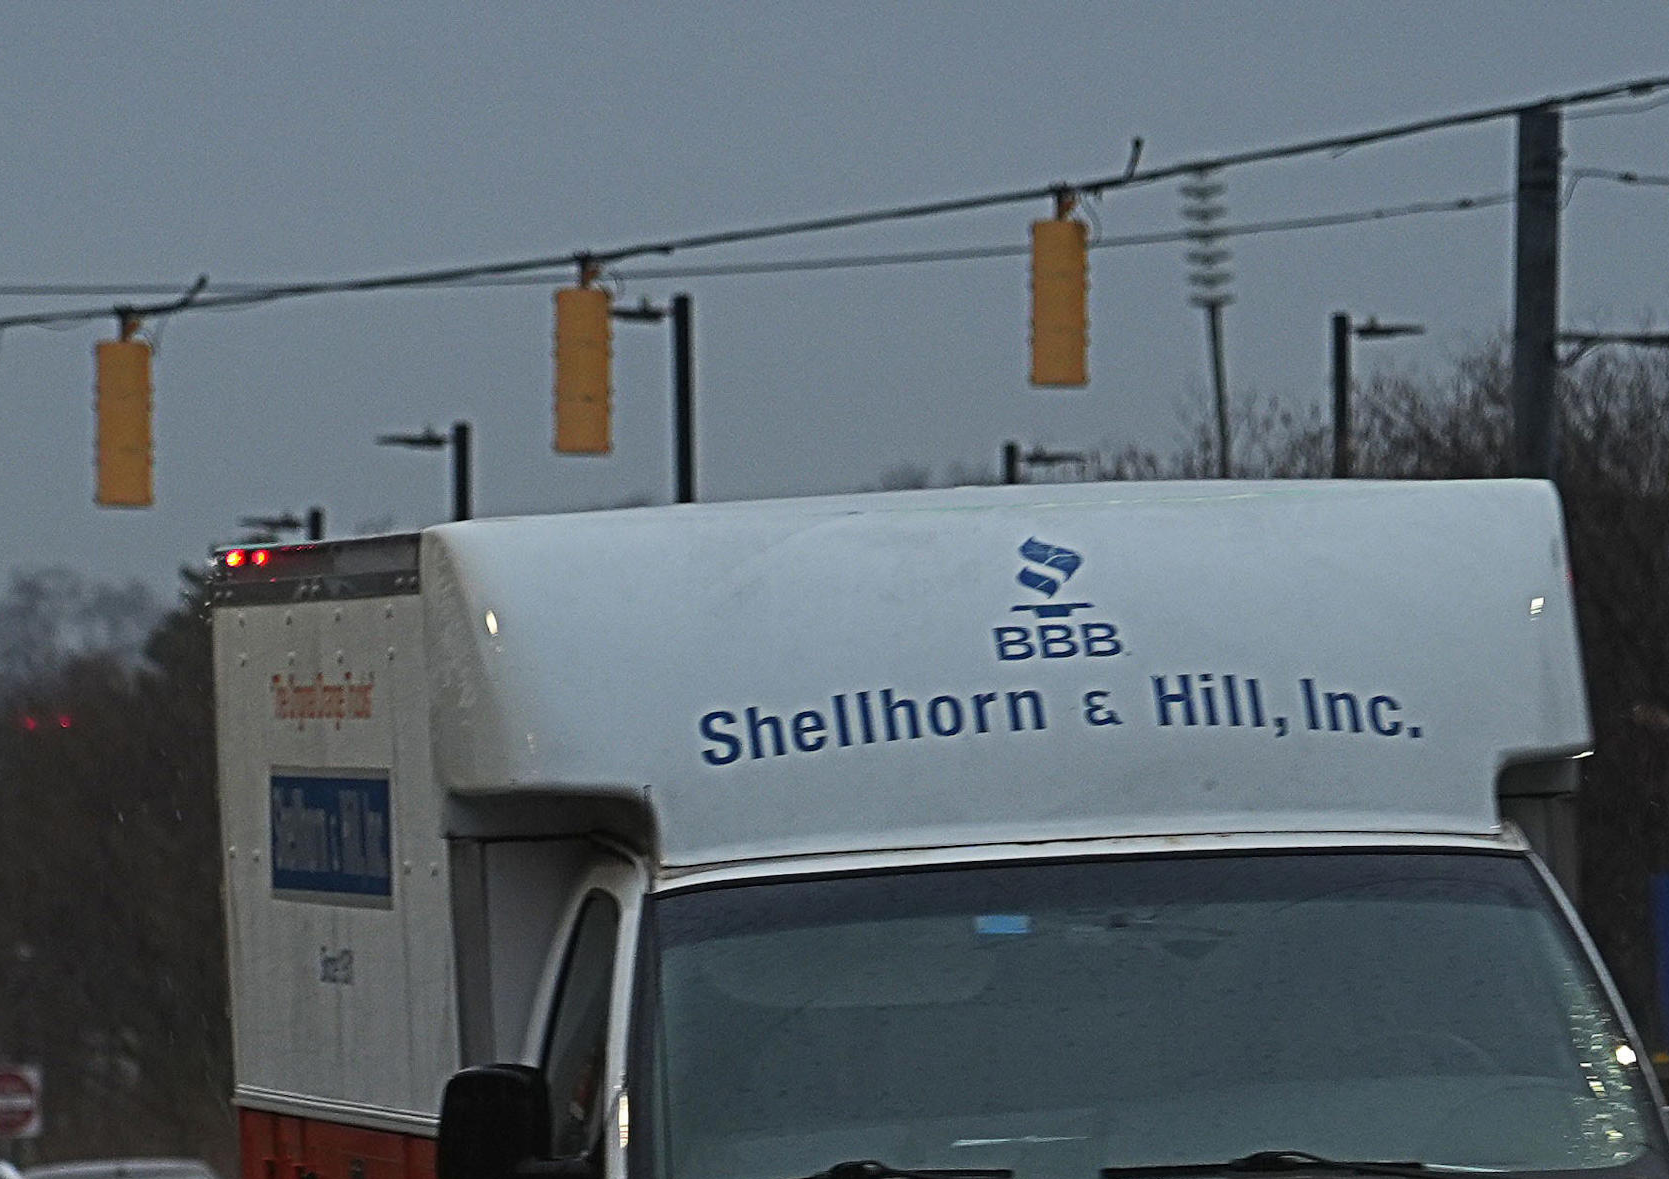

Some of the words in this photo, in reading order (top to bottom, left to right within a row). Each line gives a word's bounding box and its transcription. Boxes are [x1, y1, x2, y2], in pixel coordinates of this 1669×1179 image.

[993, 622, 1123, 661] BBB
[698, 687, 1048, 766] Shellhorn
[1083, 690, 1123, 727] &
[1150, 673, 1289, 738] Hill,
[1299, 678, 1424, 739] Inc.
